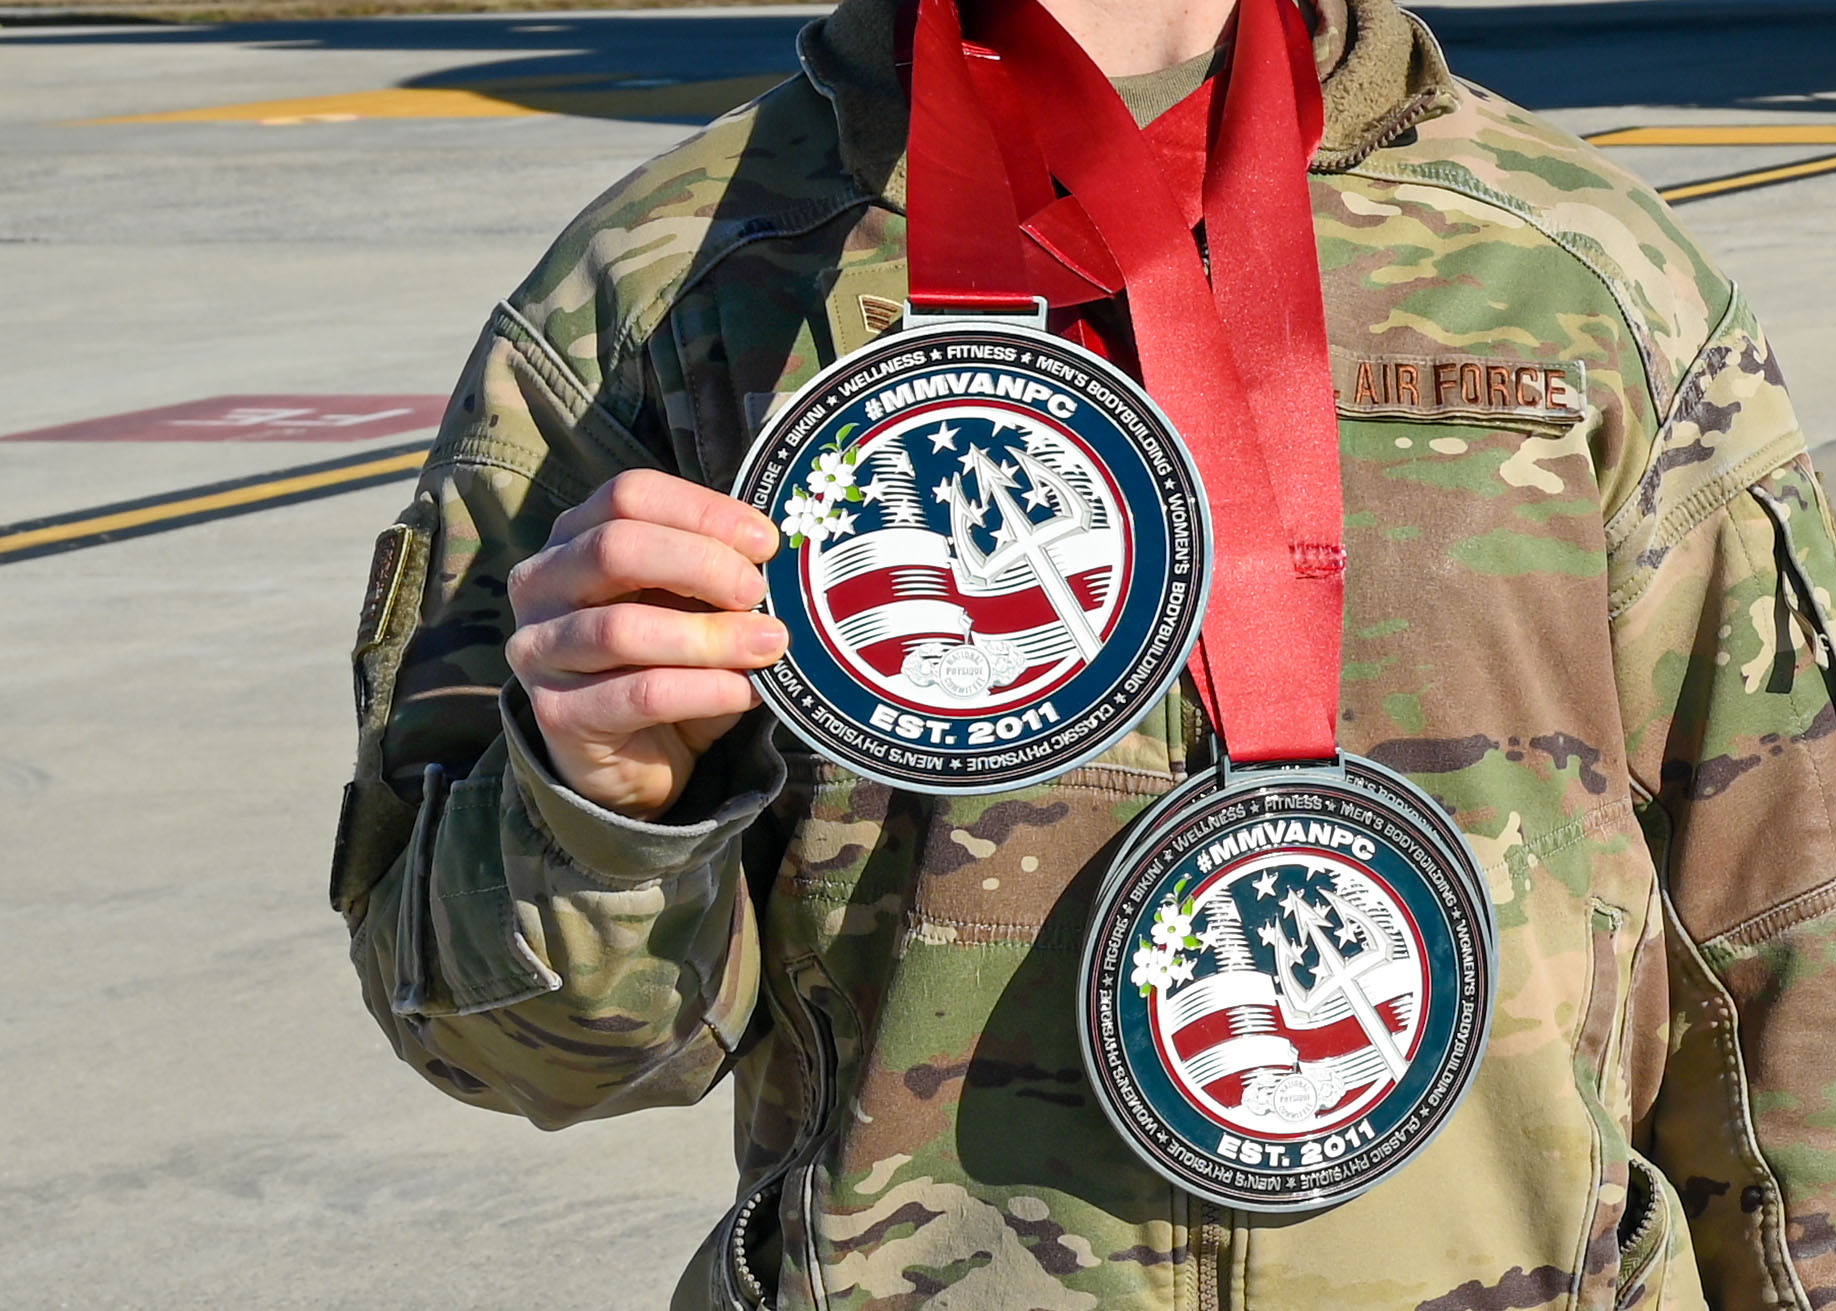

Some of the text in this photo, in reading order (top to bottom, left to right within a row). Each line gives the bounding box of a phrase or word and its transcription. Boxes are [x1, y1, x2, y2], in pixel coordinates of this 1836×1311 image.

[838, 351, 926, 396] WELLNESS
[947, 345, 1017, 361] FITNESS
[1036, 355, 1089, 387] MEN'S
[865, 372, 1077, 421] #MMVANPC
[1354, 362, 1568, 410] AIR FORCE
[785, 404, 826, 447] BIKINI
[1086, 380, 1172, 475] BODYBUILDING
[1168, 493, 1190, 574] WOMEN'S
[1124, 582, 1186, 693] BODYBUILDING
[811, 706, 887, 757] PHYSIQUE
[869, 701, 1060, 745] EST. 2011
[1051, 704, 1115, 749] CLASSIC
[888, 748, 943, 770] MEN'S
[966, 741, 1052, 771] PHYSIQUE
[1264, 794, 1322, 810] FITNESS
[1340, 801, 1384, 830] MEN'S
[1172, 803, 1246, 852] WELLNESS
[1197, 821, 1375, 873] #MMVANPC
[1130, 858, 1164, 902] BIKINI
[1384, 822, 1457, 907] BODYBUILDING
[1103, 915, 1129, 971] FIGURE
[1456, 919, 1475, 995] WOMEN'S
[1099, 989, 1121, 1067] PHYSIQUE
[1428, 1000, 1474, 1106] BODYBUILDING
[1113, 1065, 1158, 1135] WOMEN'S
[1167, 1138, 1233, 1182] PHYSIQUE
[1217, 1118, 1375, 1166] EST. 2011
[1370, 1115, 1420, 1162] CLASSIC
[1234, 1171, 1281, 1190] MEN'S
[1300, 1154, 1369, 1189] PHYSIQUE
